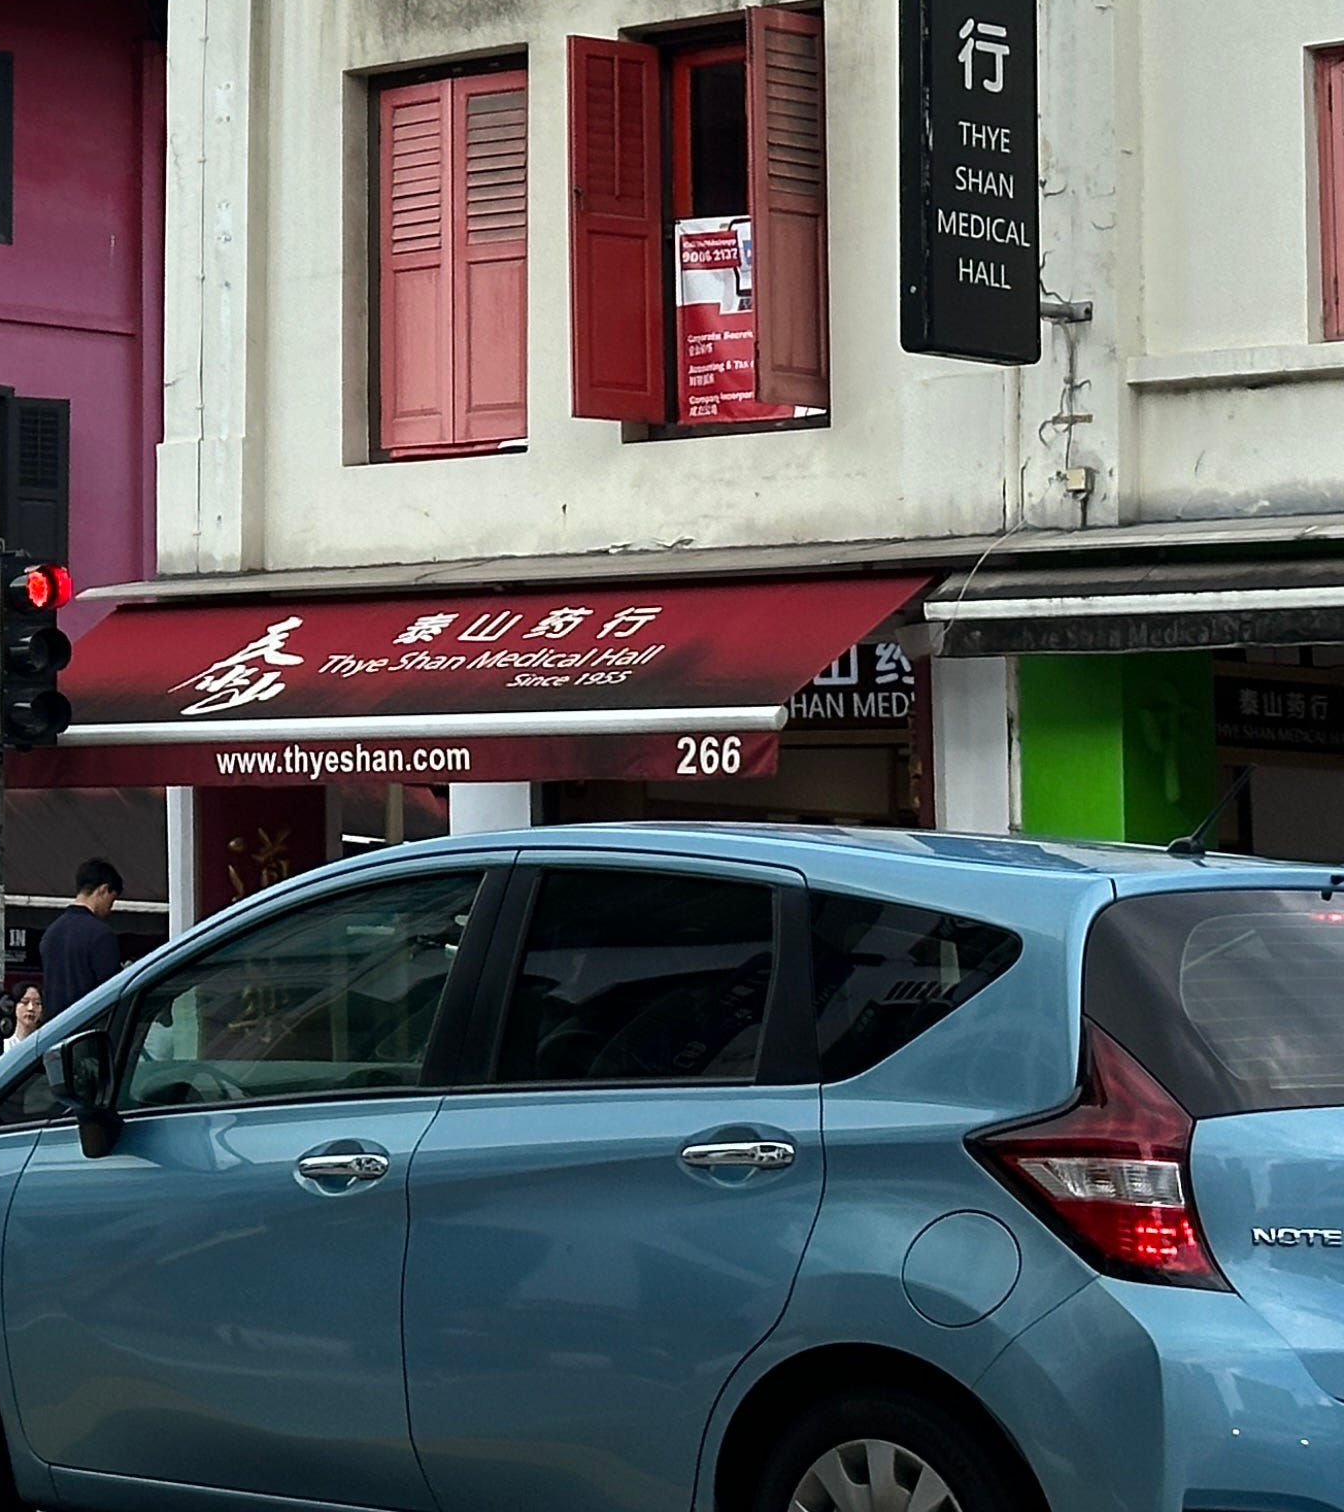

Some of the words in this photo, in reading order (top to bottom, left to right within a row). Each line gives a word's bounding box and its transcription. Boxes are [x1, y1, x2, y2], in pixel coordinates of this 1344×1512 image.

[958, 122, 1012, 154] THYE
[955, 166, 1015, 198] SHAN
[937, 210, 1032, 248] MEDICAL
[958, 258, 1012, 289] HALL
[393, 606, 662, 644] 泰山药行
[318, 654, 388, 678] Thye
[388, 651, 467, 673] Shan
[466, 647, 596, 671] Medical
[589, 644, 666, 666] Hall
[505, 672, 570, 688] Since
[574, 670, 634, 686] 1955
[791, 692, 844, 719] HAN
[216, 744, 471, 780] www.thyeshan.com
[676, 736, 741, 774] 266
[1252, 1227, 1343, 1247] NOTE
